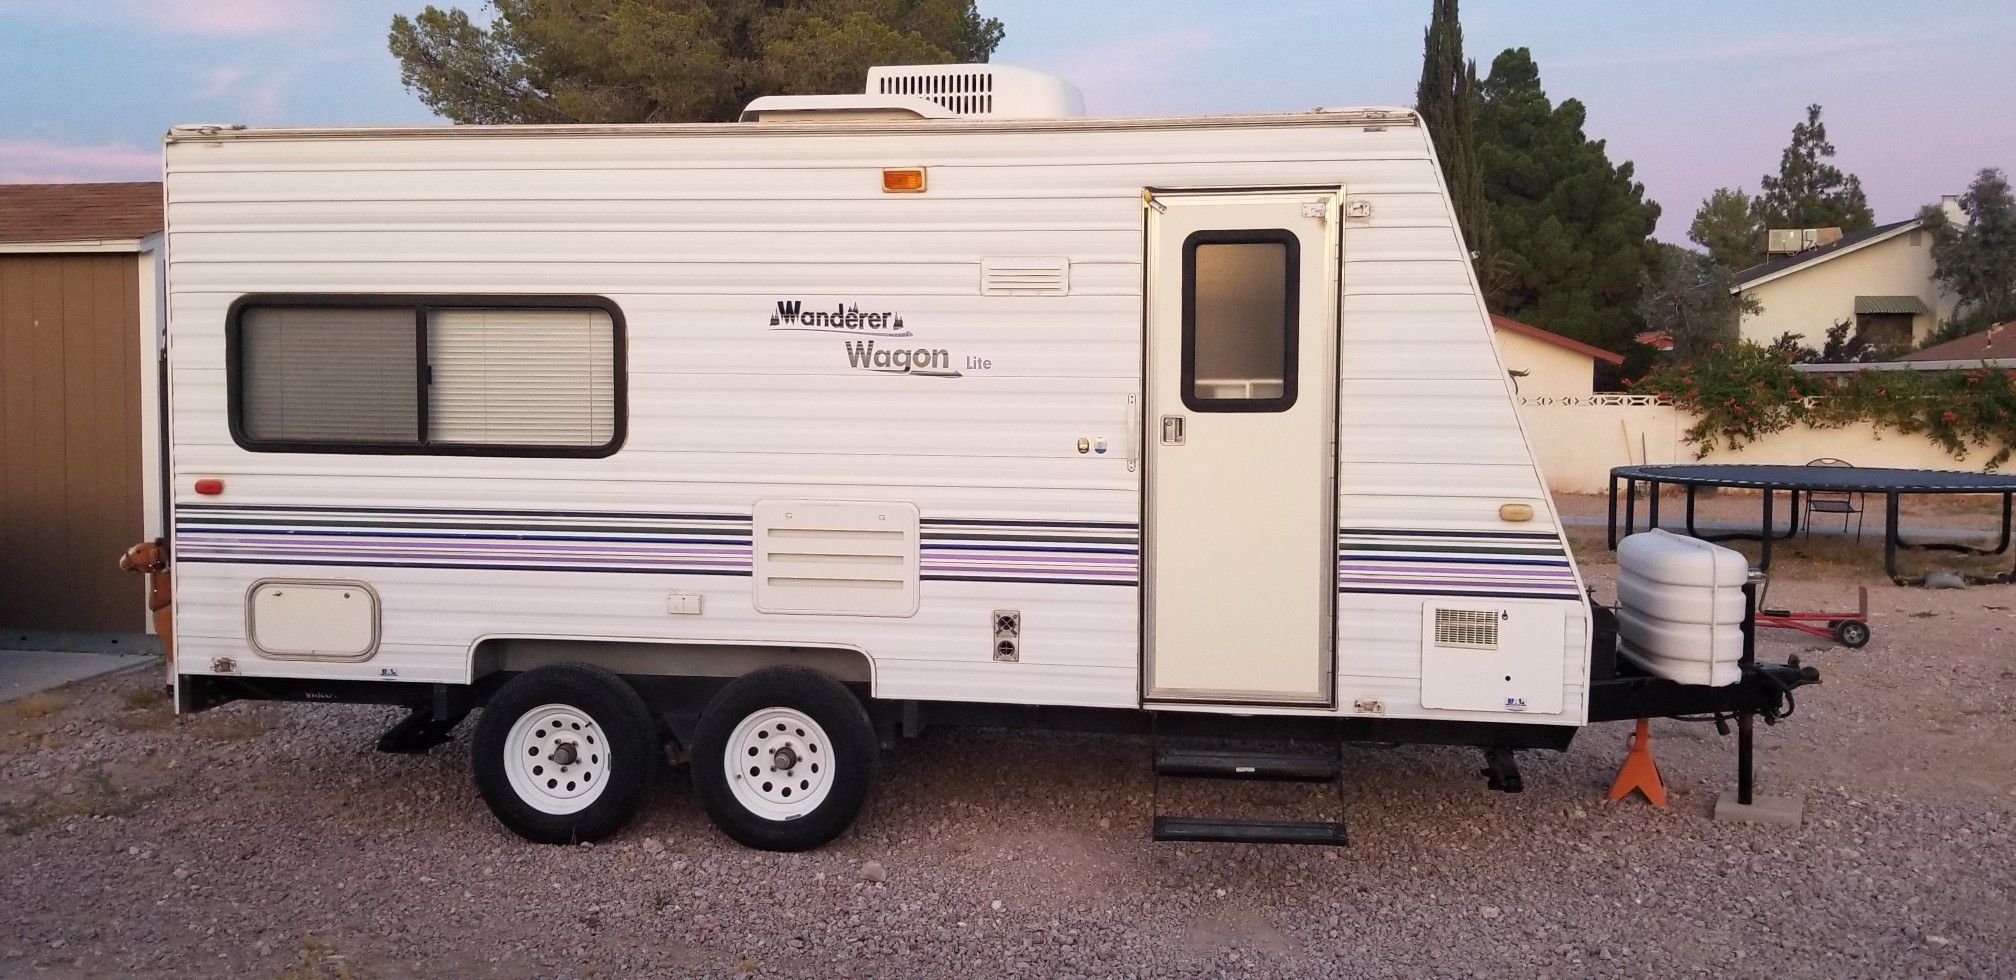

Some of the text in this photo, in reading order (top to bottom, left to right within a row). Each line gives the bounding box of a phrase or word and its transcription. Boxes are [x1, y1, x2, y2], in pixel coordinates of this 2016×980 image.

[777, 300, 892, 329] Wanderer
[845, 340, 992, 372] Wagon Lite
